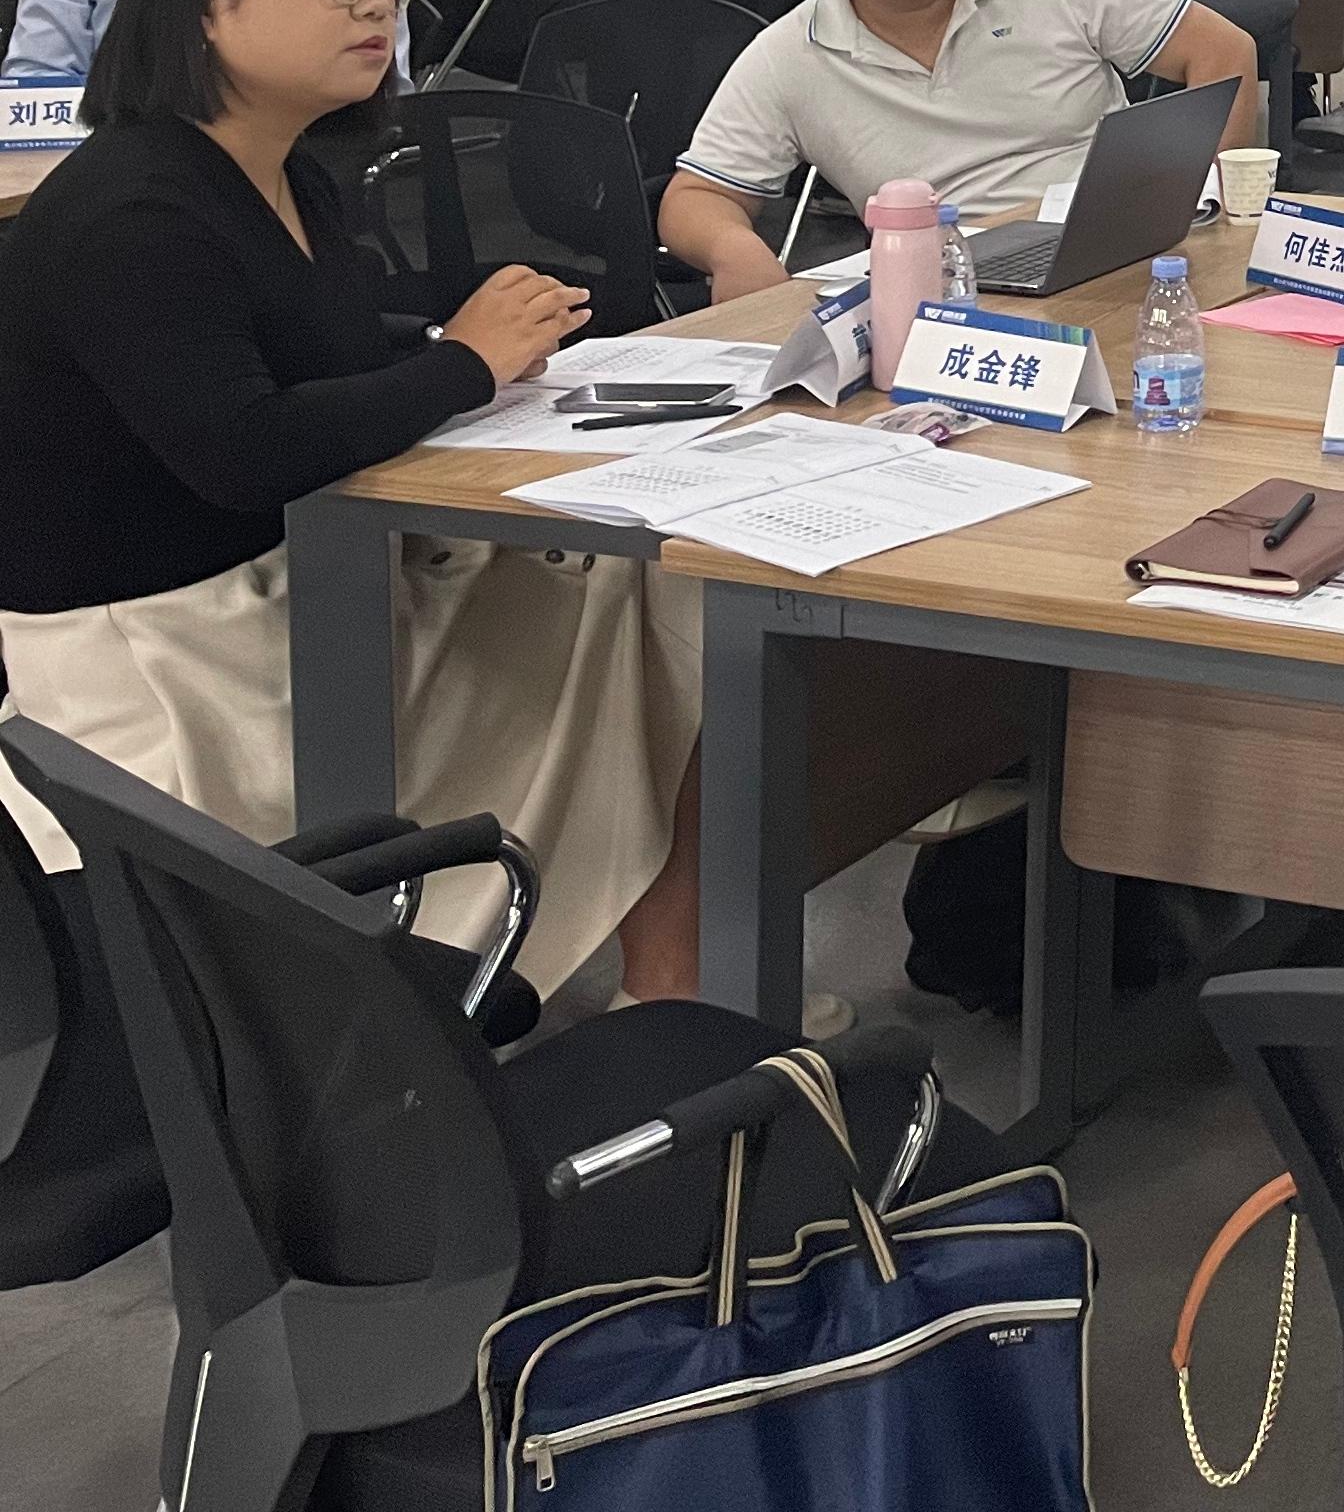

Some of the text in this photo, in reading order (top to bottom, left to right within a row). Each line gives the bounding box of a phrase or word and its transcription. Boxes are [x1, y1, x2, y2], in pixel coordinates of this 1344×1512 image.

[9, 100, 72, 126] 刘项
[939, 344, 1041, 391] 成金锋
